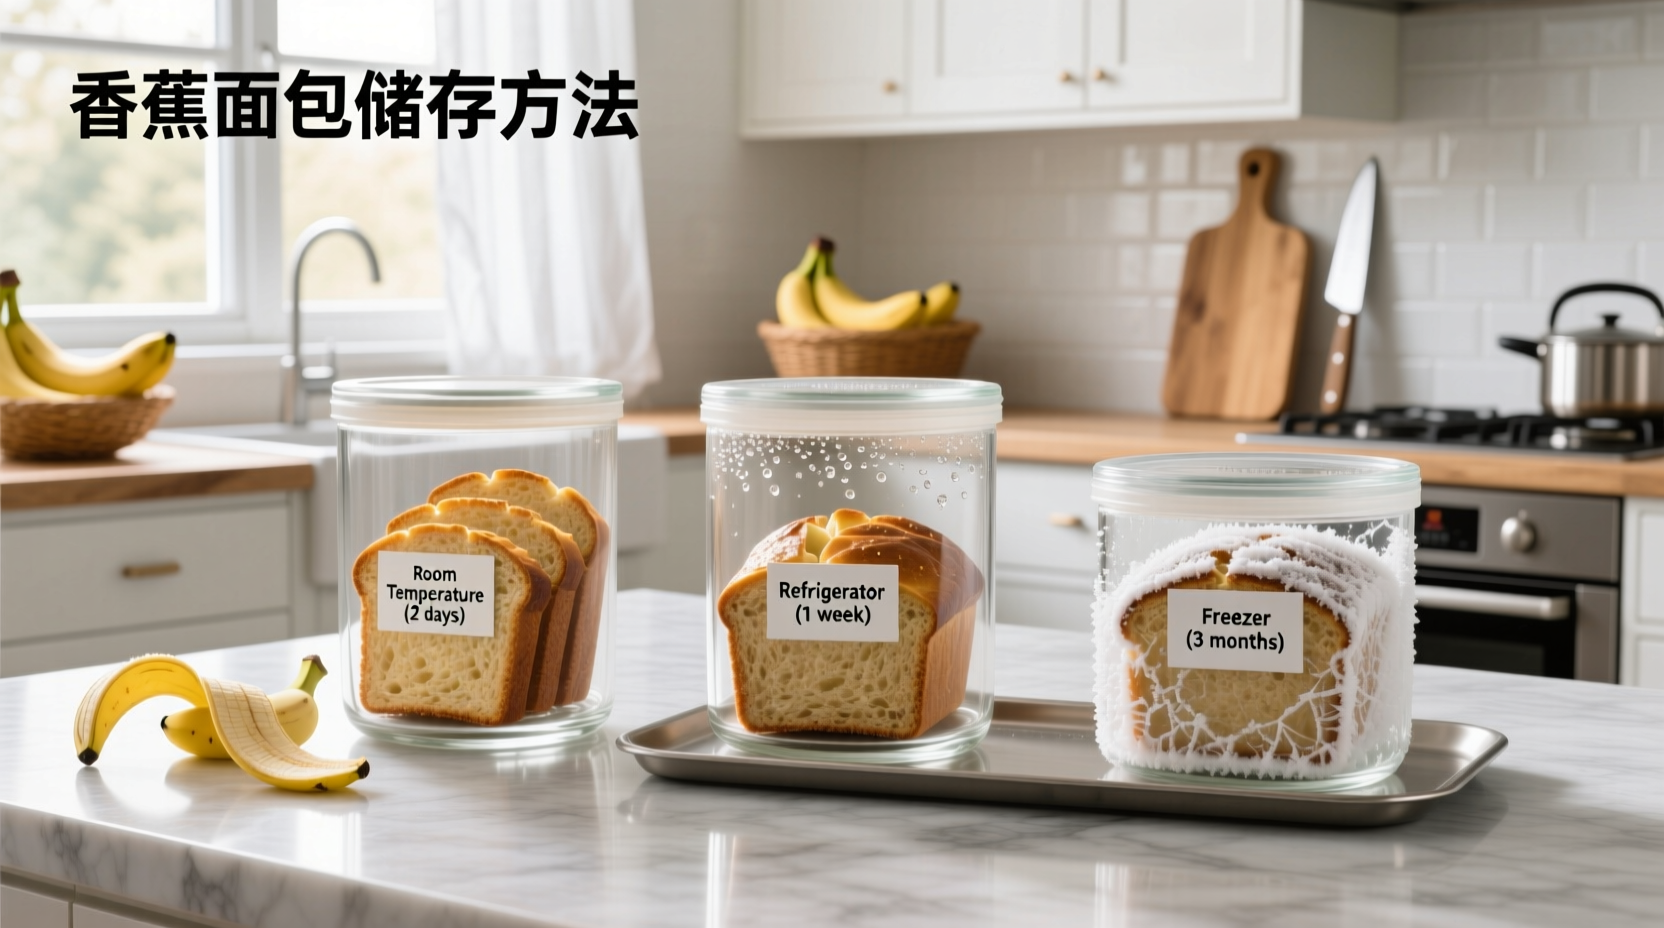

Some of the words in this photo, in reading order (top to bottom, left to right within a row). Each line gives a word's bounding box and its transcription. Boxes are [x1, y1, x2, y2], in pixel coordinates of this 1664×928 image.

[413, 565, 457, 582] Room
[386, 583, 485, 605] Temperature
[779, 580, 886, 604] Refrigerator
[404, 603, 420, 625] (2
[424, 605, 466, 627] days)
[795, 603, 811, 626] (1
[816, 604, 872, 627] week)
[1202, 607, 1272, 627] Freezer
[1186, 628, 1204, 652] (3
[1209, 631, 1285, 655] months)
